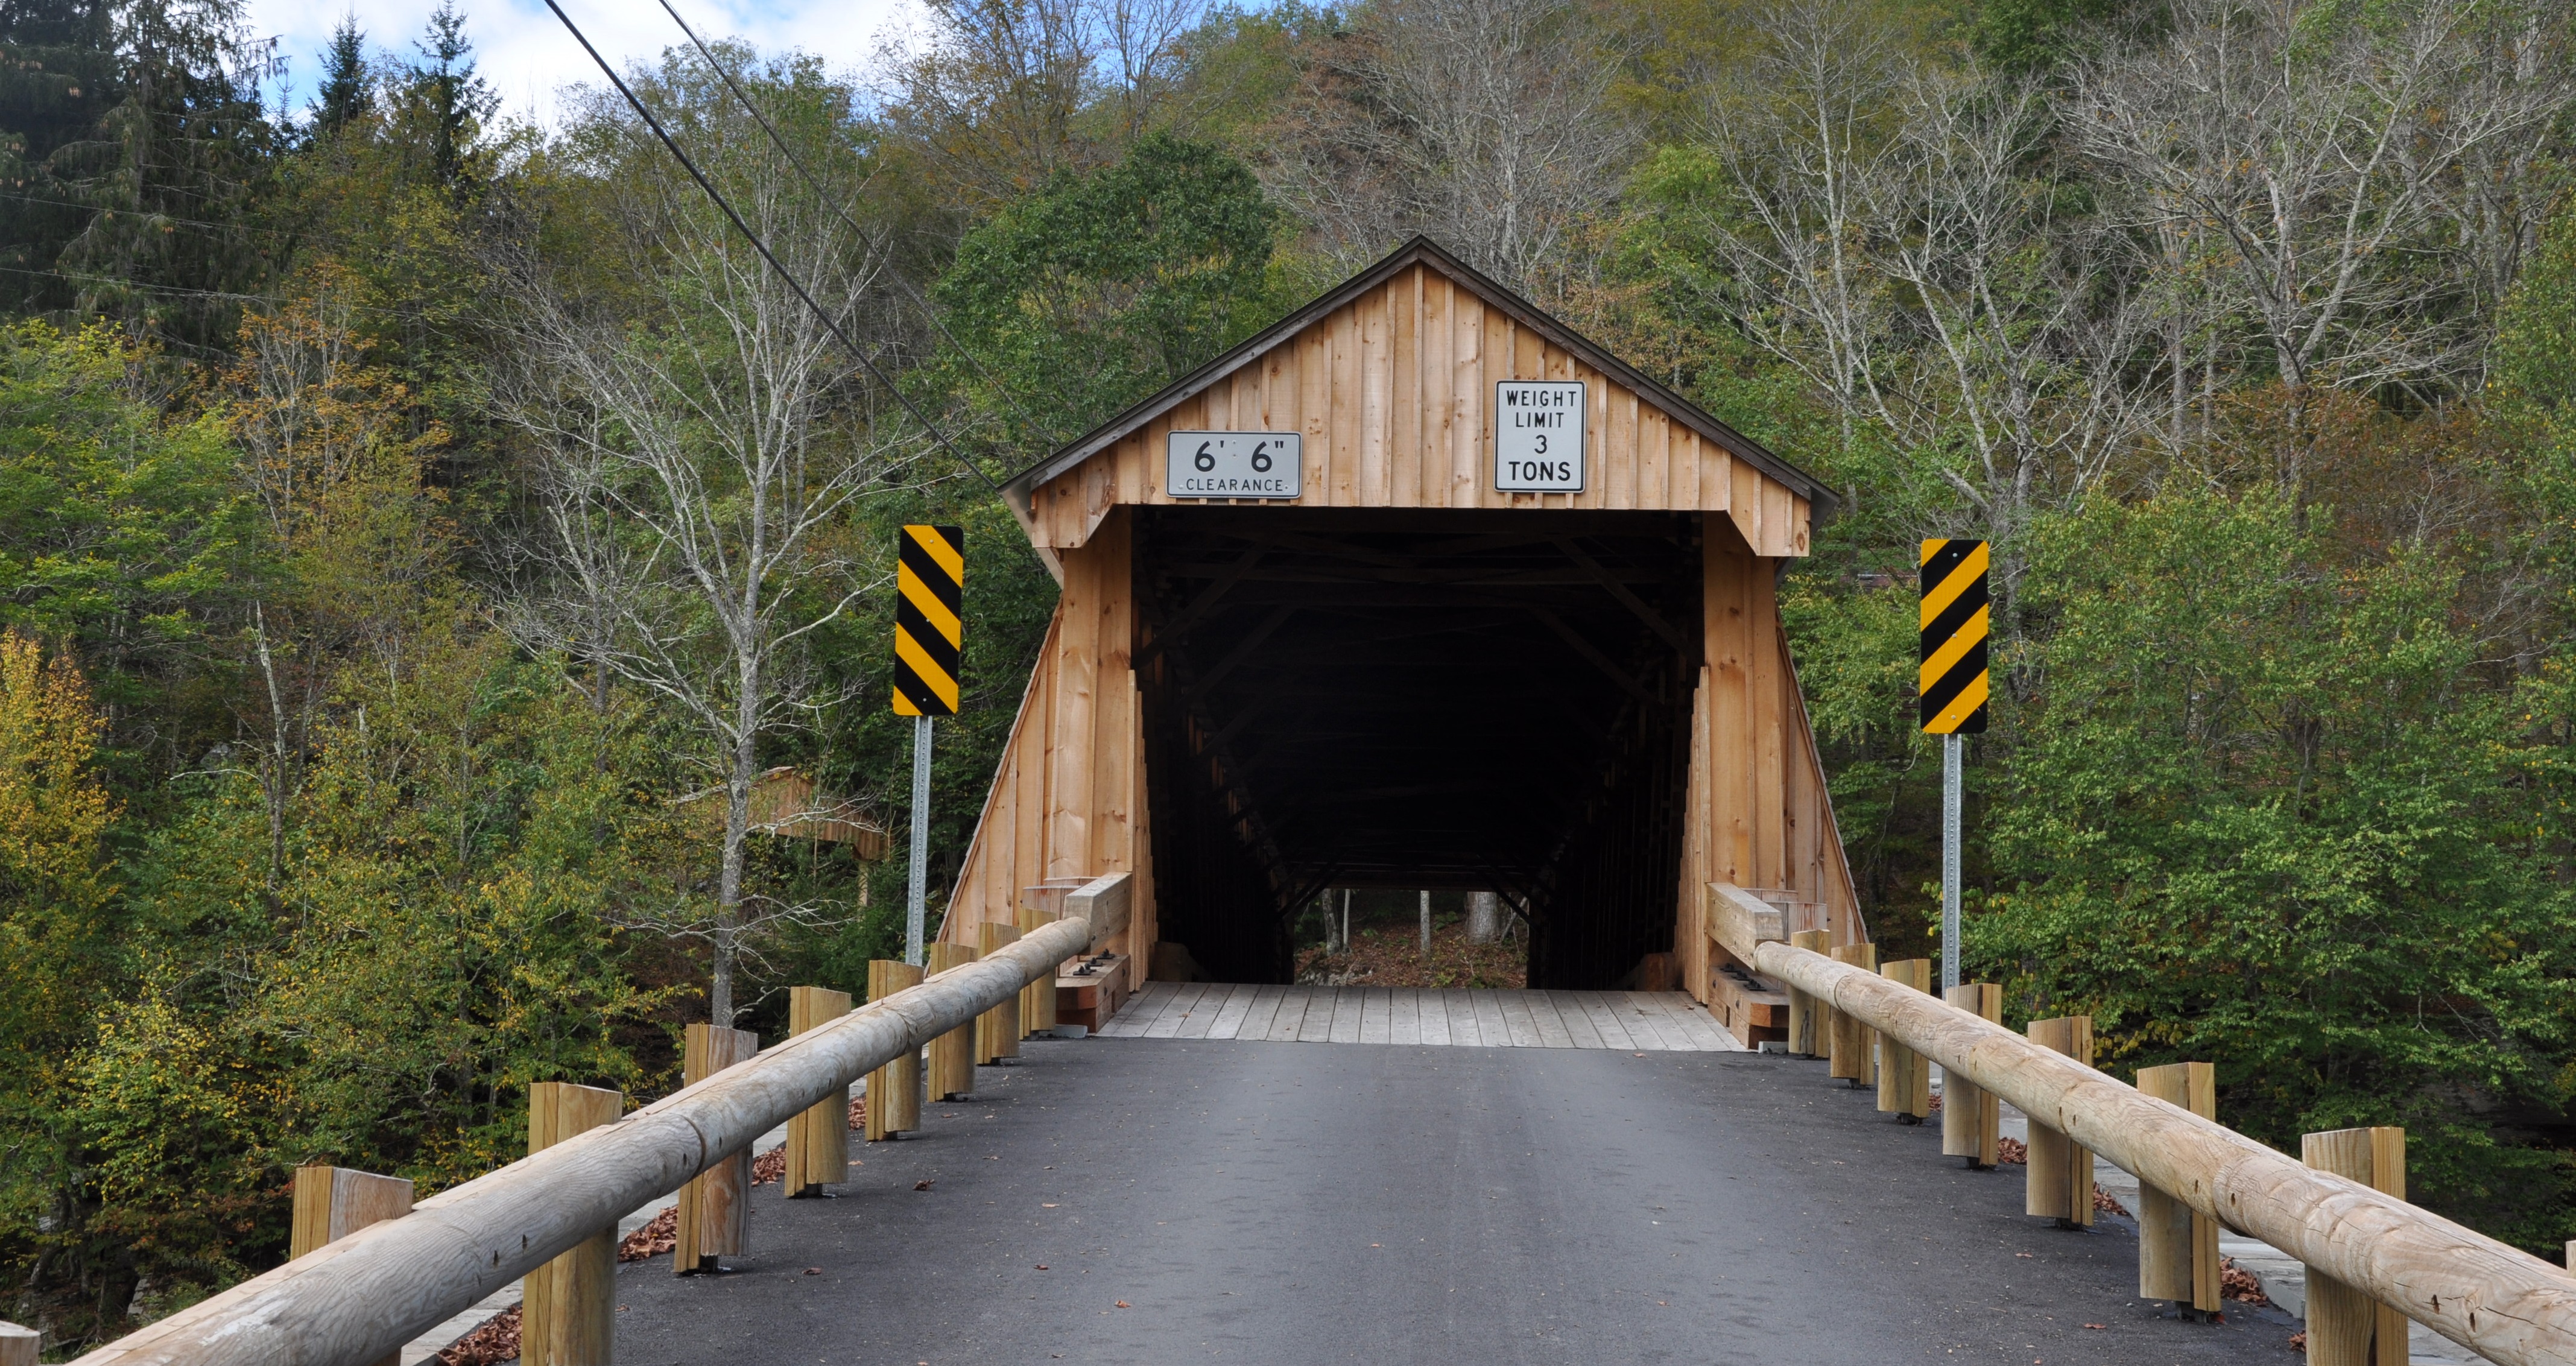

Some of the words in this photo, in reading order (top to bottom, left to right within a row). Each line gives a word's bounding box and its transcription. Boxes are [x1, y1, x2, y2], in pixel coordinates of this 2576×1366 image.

[1507, 390, 1577, 406] WEIGHT
[1516, 412, 1564, 428] LIMIT
[1534, 434, 1547, 454] 3
[1194, 440, 1224, 472] 6'
[1251, 440, 1284, 473] 6"
[1508, 461, 1571, 481] TONS
[1186, 478, 1283, 492] CLEARANCE
